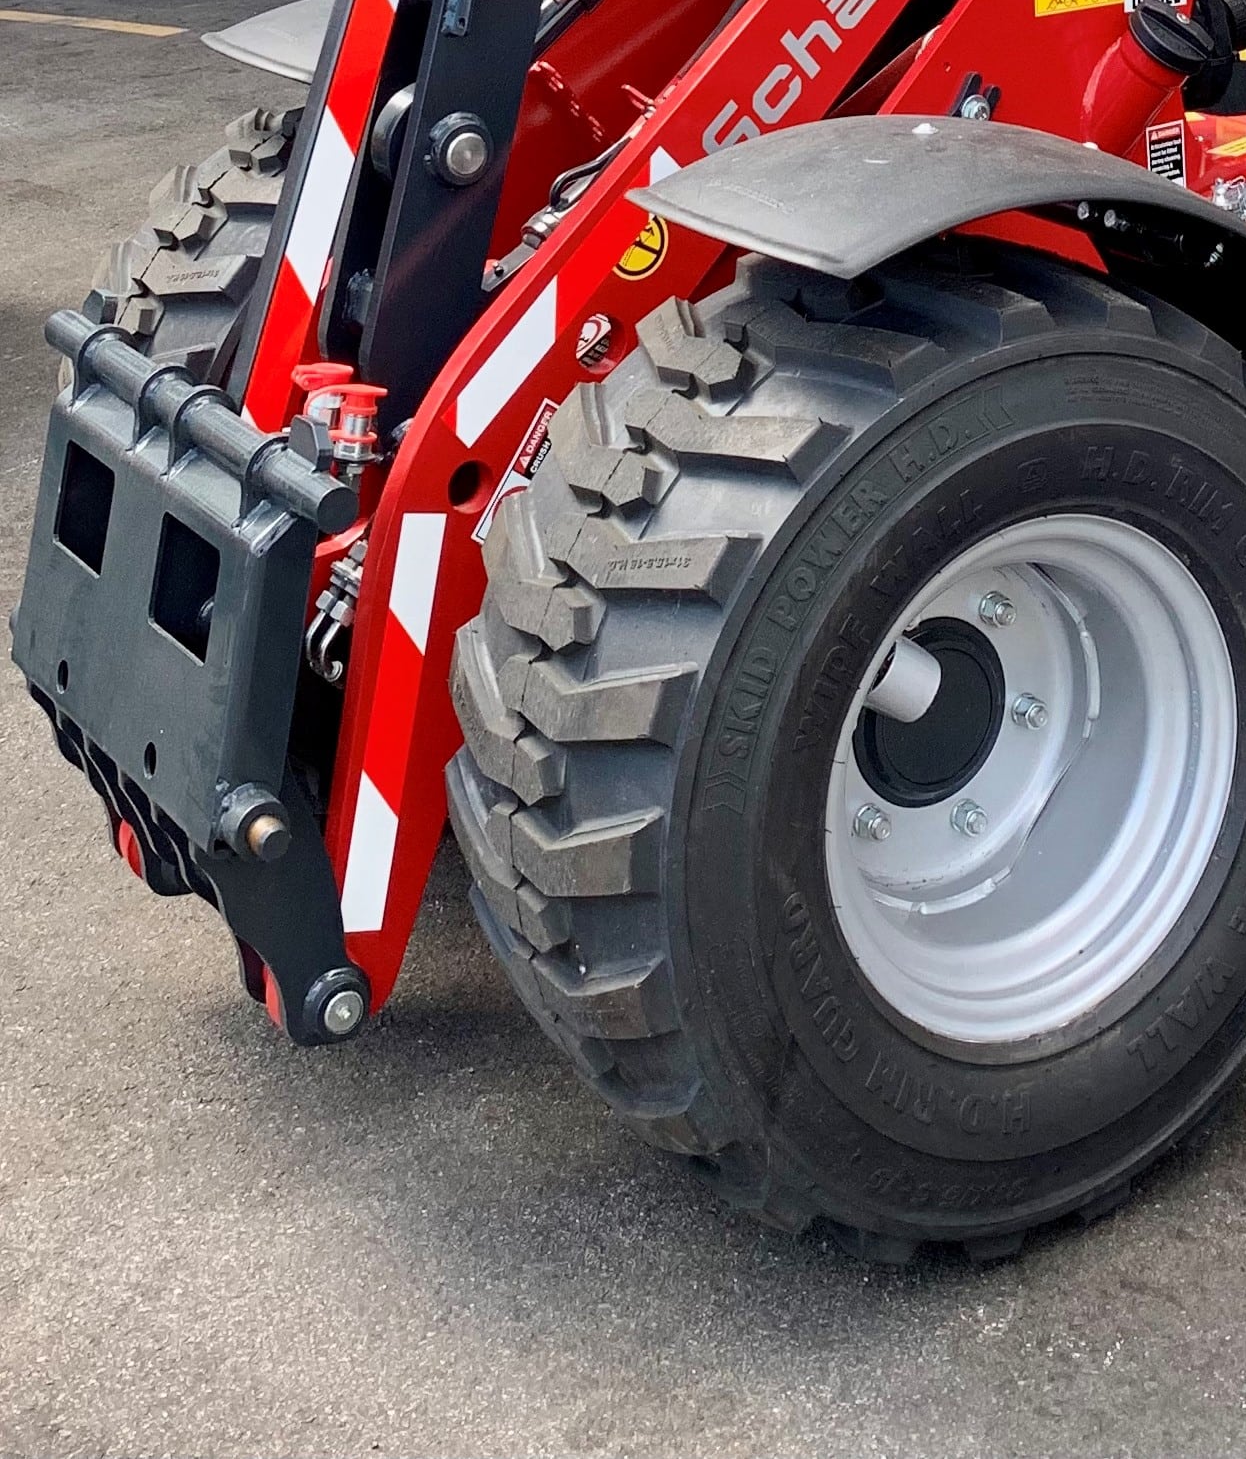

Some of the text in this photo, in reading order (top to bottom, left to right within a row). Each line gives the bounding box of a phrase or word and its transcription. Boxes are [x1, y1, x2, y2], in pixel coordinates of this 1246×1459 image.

[525, 410, 553, 454] DANGER
[530, 440, 552, 473] CRUSH
[1080, 445, 1160, 487] H.D.
[1166, 462, 1235, 536] RIM
[719, 646, 778, 760] SKID
[766, 479, 889, 633] POWER
[782, 891, 859, 1063] GUARD
[1127, 956, 1236, 1073] WALL
